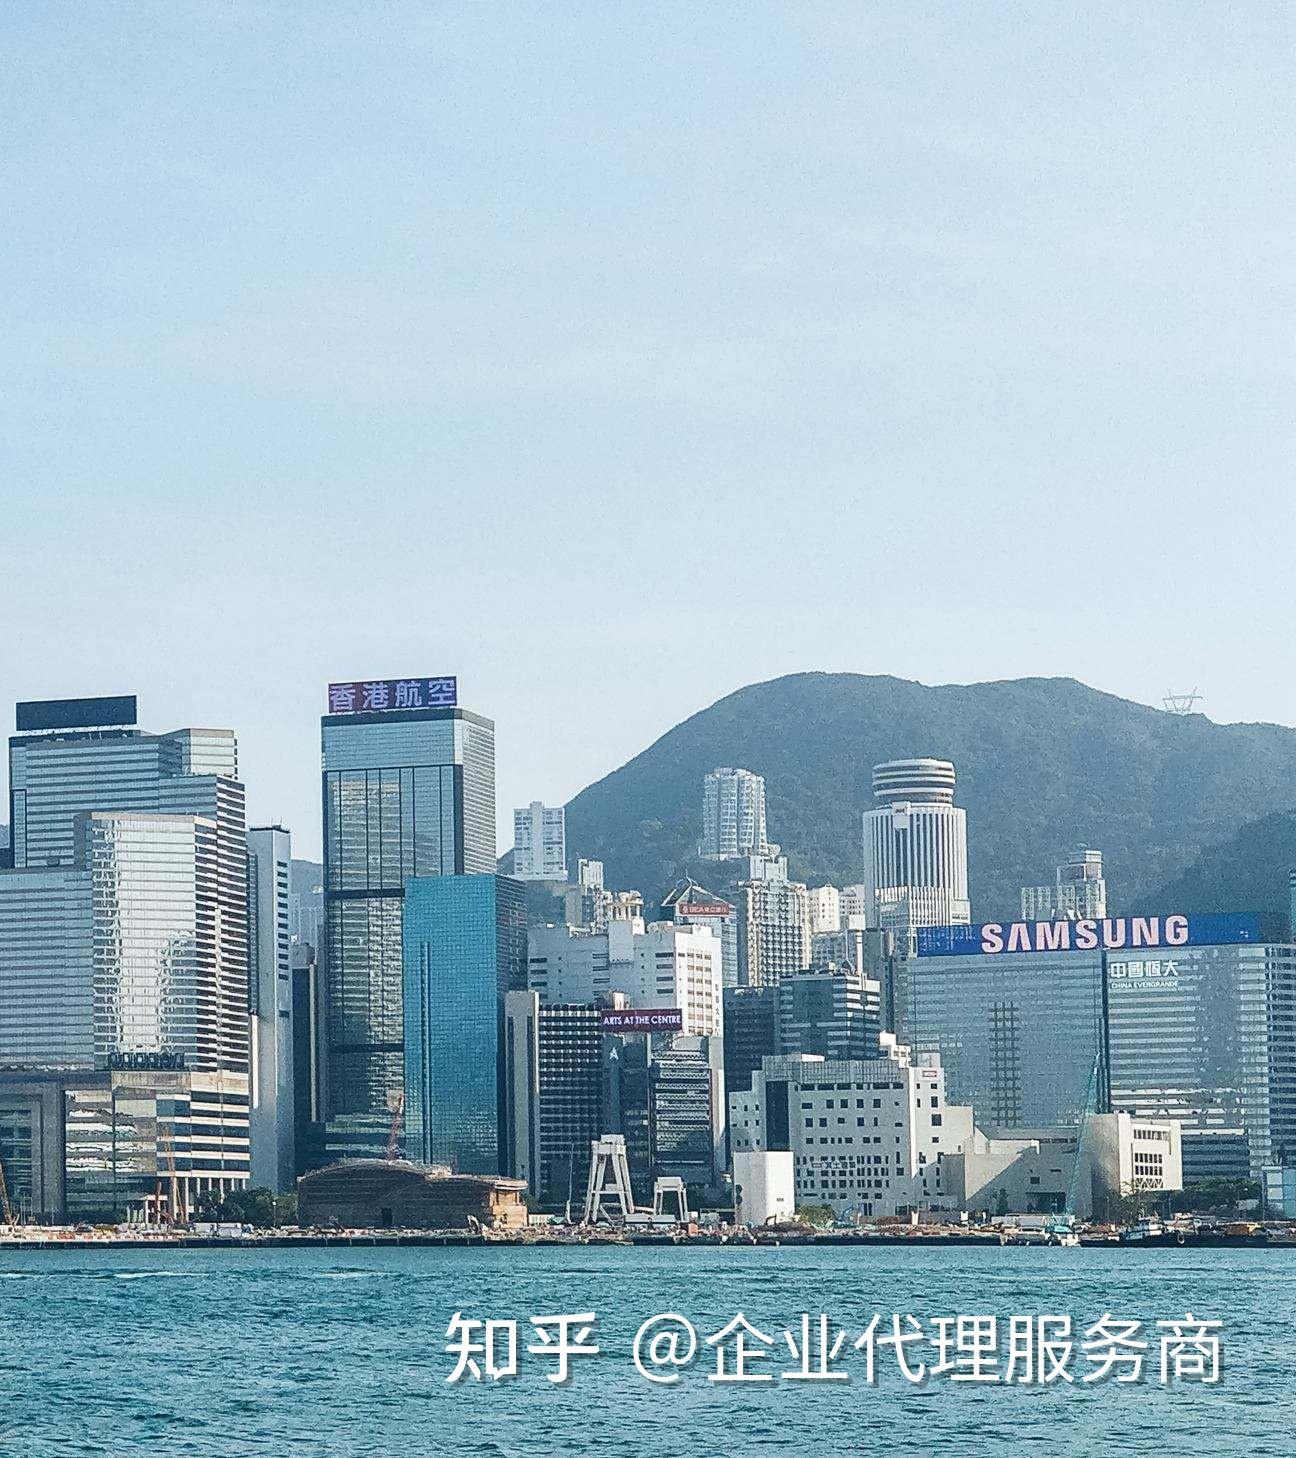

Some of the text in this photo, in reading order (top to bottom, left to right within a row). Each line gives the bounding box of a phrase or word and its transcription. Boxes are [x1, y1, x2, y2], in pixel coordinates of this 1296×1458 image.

[329, 678, 456, 712] 香港航空
[980, 915, 1189, 953] SAMSUNG
[603, 1014, 681, 1026] ARTS AT THE CENTRE
